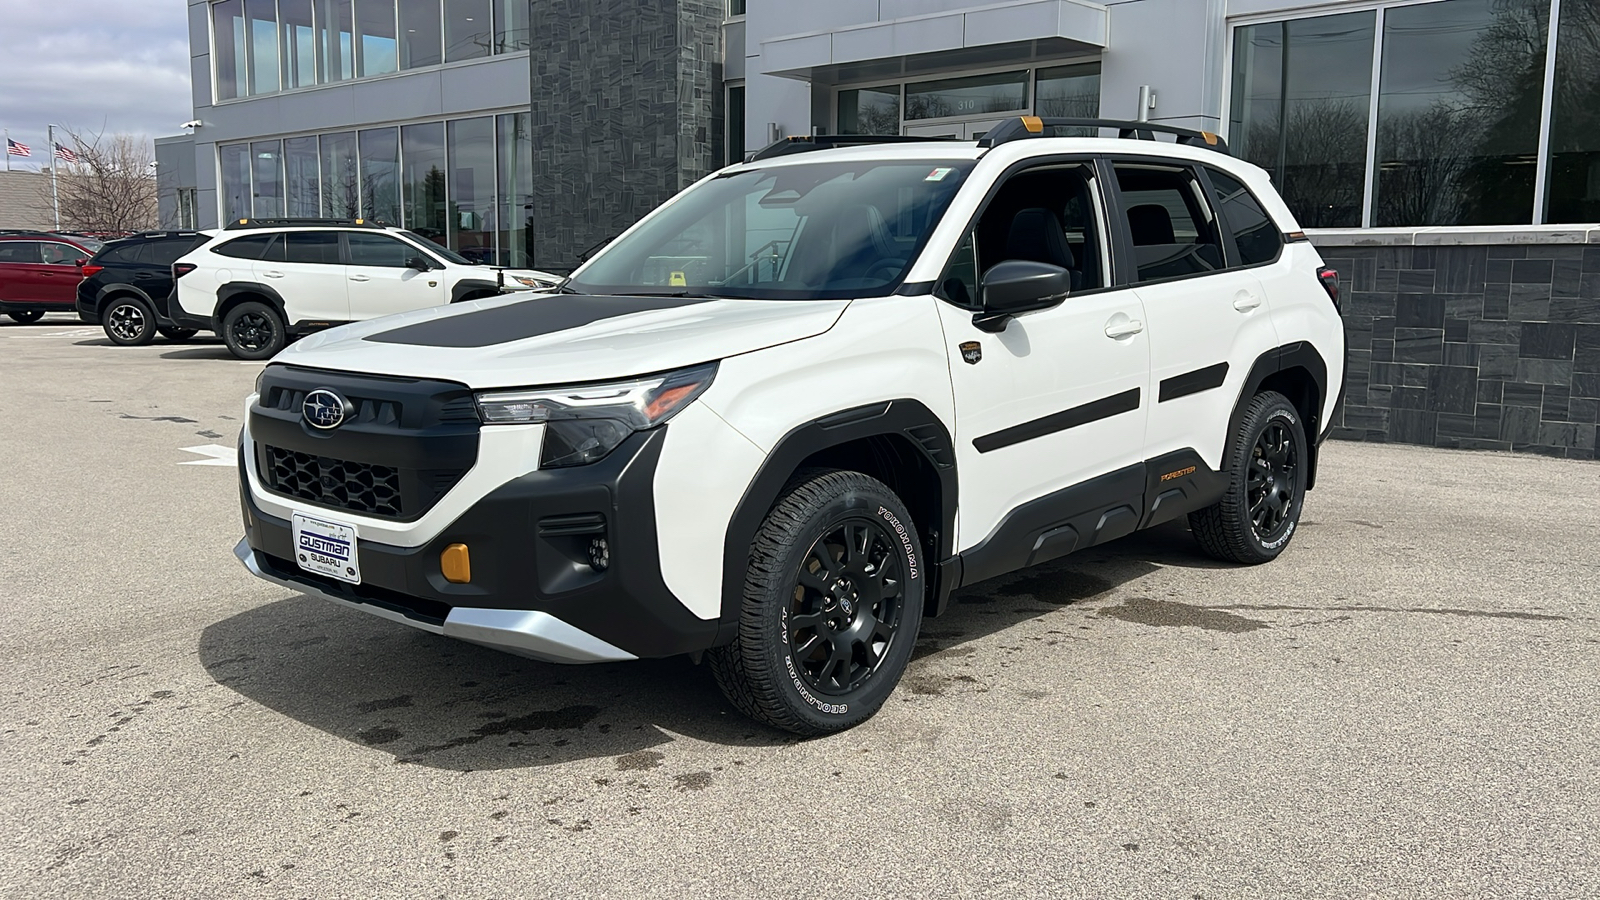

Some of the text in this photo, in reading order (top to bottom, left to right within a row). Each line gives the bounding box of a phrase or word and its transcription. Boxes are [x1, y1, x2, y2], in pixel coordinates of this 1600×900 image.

[958, 100, 975, 110] 310
[1160, 465, 1196, 482] FORESTER
[878, 506, 918, 579] YOKOHAMA
[311, 553, 341, 568] SUBARU
[785, 655, 848, 714] GEOLANDAR
